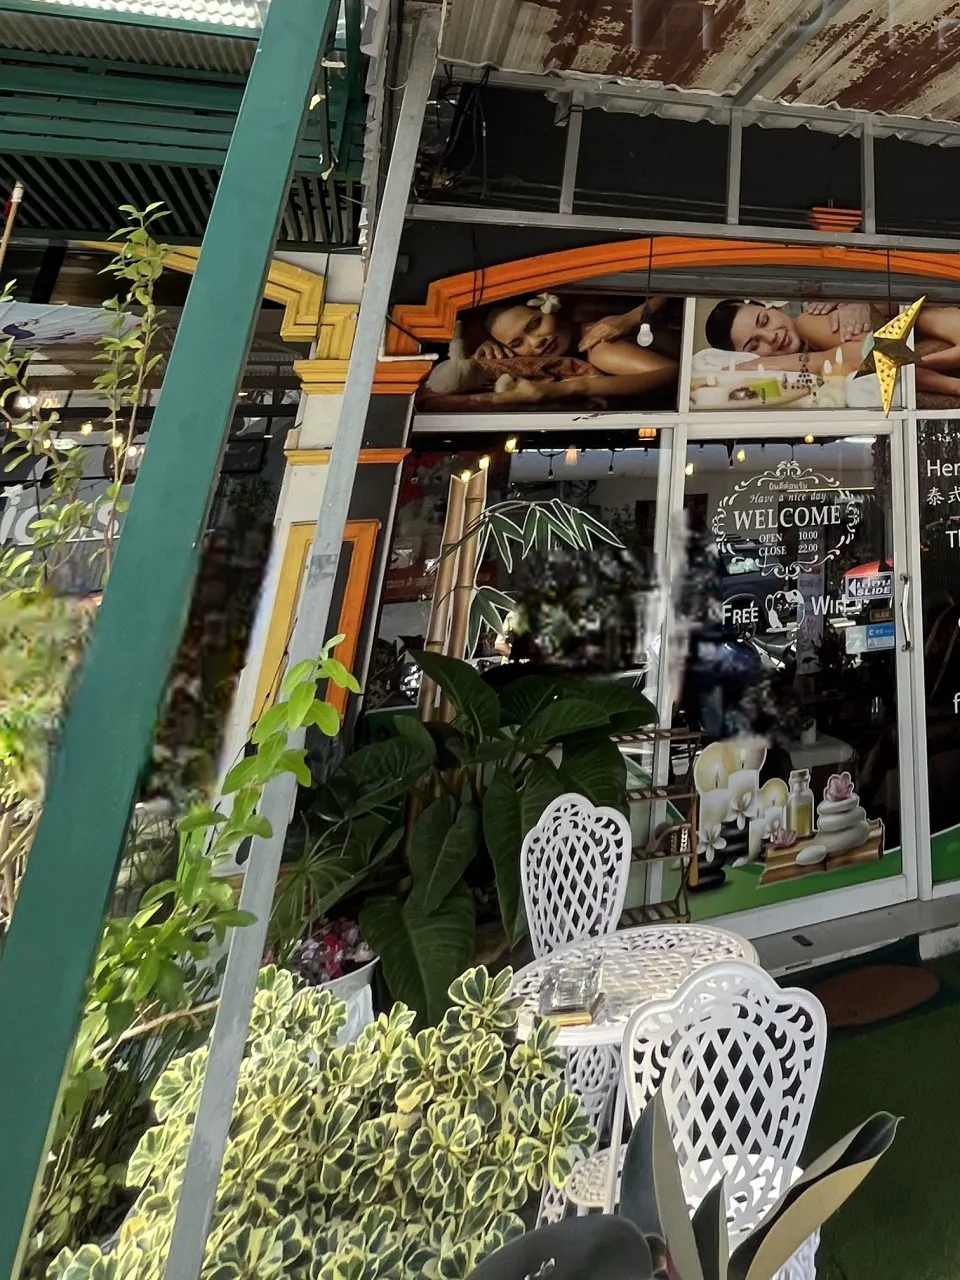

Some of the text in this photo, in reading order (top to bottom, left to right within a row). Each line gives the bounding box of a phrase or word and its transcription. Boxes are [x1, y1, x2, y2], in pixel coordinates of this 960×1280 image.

[750, 492, 774, 504] Have
[788, 492, 806, 502] nice
[810, 491, 827, 503] day
[733, 505, 841, 531] WELCOME
[759, 531, 818, 543] OPEN 10.00
[758, 544, 818, 557] CLOSE 22.00
[856, 586, 891, 596] SLIDE
